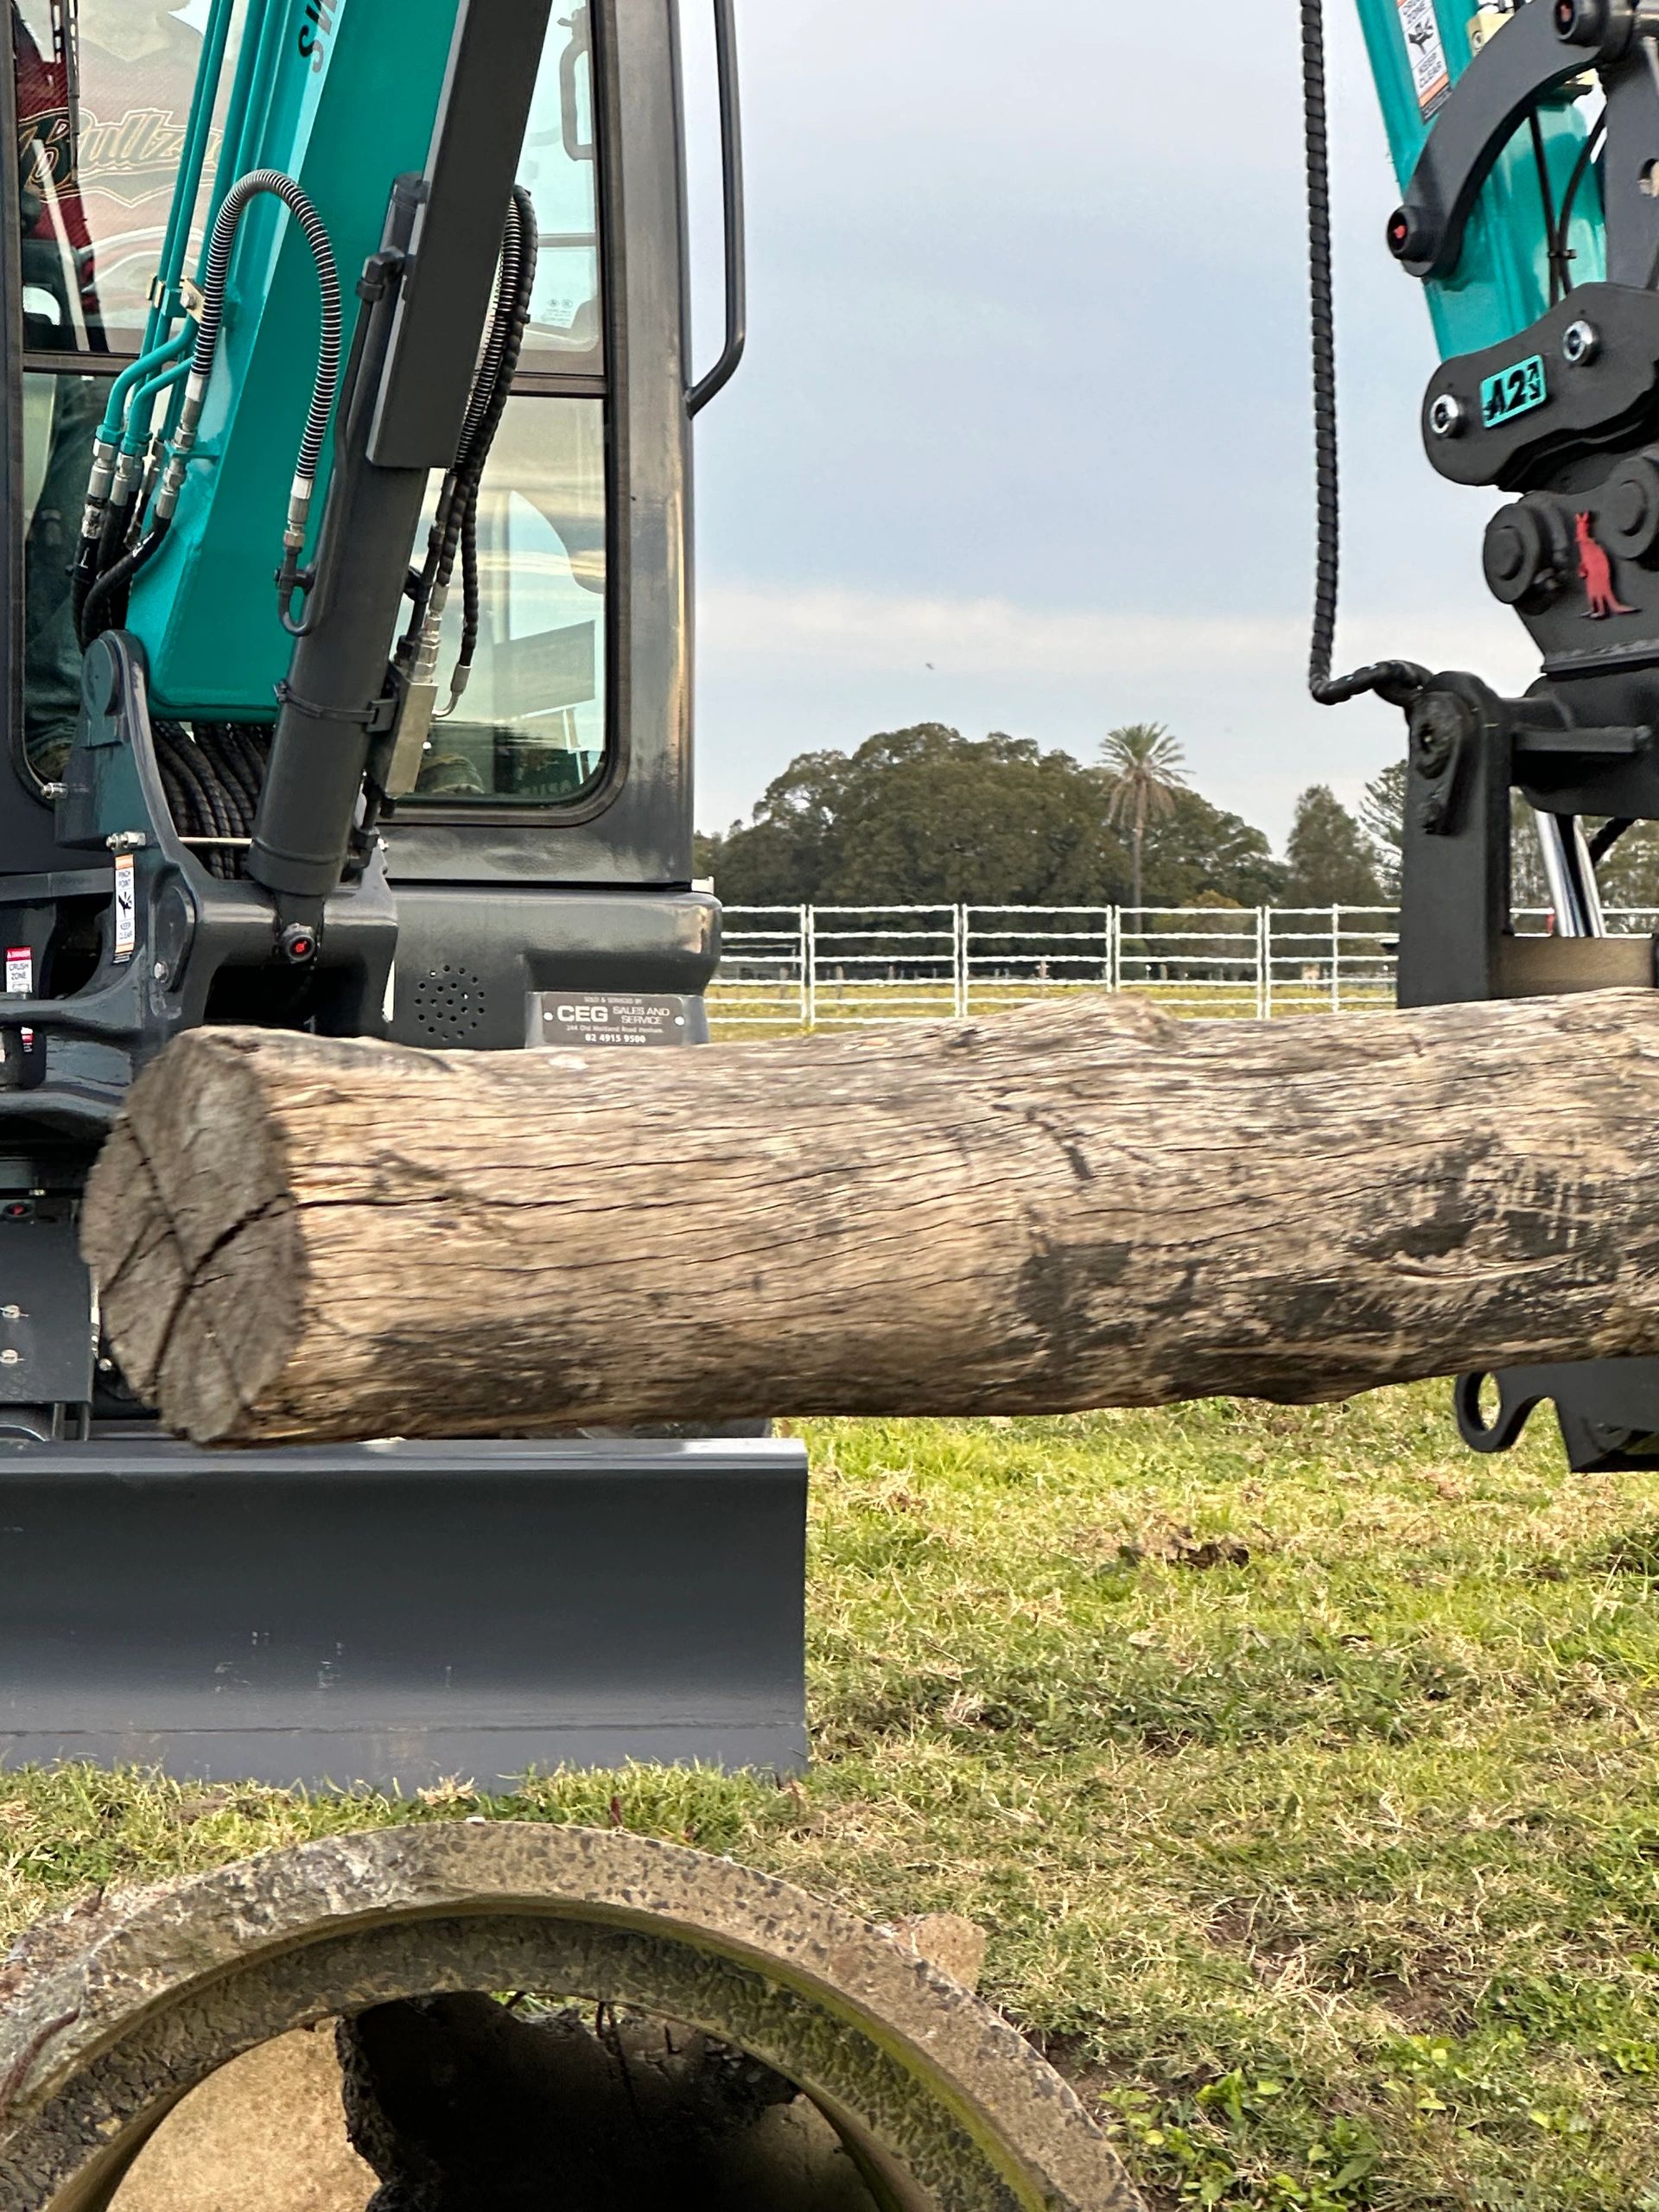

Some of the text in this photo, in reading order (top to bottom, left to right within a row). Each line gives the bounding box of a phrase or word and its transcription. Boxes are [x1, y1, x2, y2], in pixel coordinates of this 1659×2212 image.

[557, 1006, 608, 1022] CEG
[613, 1006, 670, 1016] SALES AND
[621, 1015, 663, 1025] SERVICE
[585, 1033, 597, 1042] 02
[599, 1033, 621, 1043] 4915
